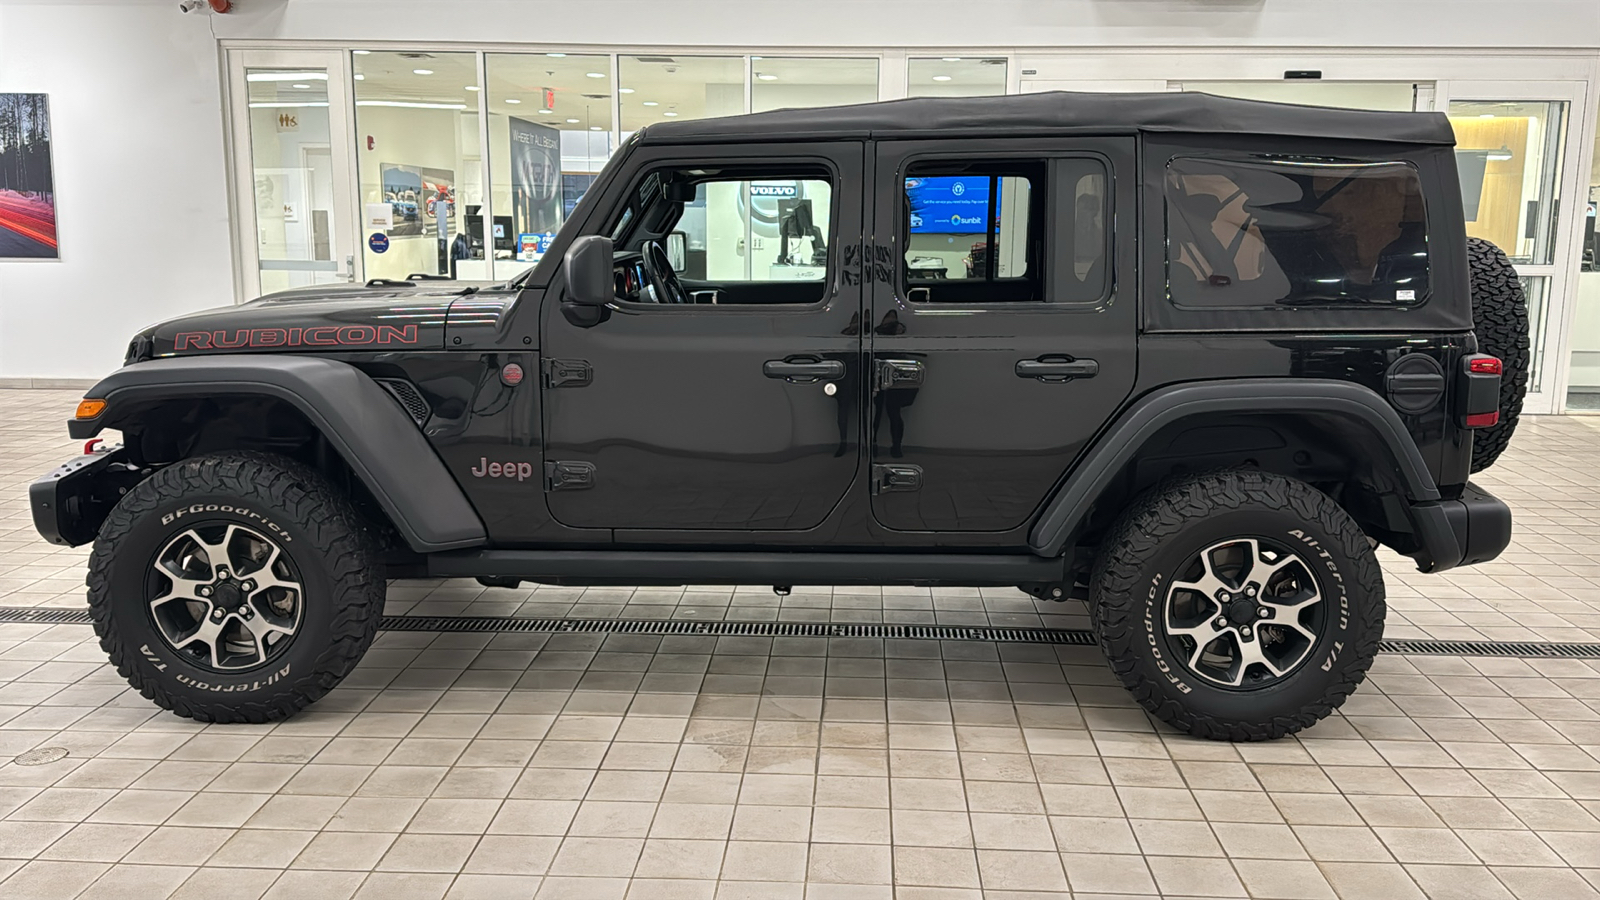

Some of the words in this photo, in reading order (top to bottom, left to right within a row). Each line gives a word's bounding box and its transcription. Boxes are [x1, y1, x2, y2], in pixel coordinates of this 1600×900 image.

[750, 186, 795, 195] VOLVO
[174, 325, 418, 350] RUBICON
[471, 457, 533, 482] Jeep
[161, 503, 292, 542] BFGoodrich
[1287, 529, 1350, 630] All-Terrain
[1321, 641, 1344, 672] T/A
[1144, 573, 1193, 694] BFGoodrich
[139, 644, 168, 673] T/A
[176, 663, 291, 692] All-Terrain
